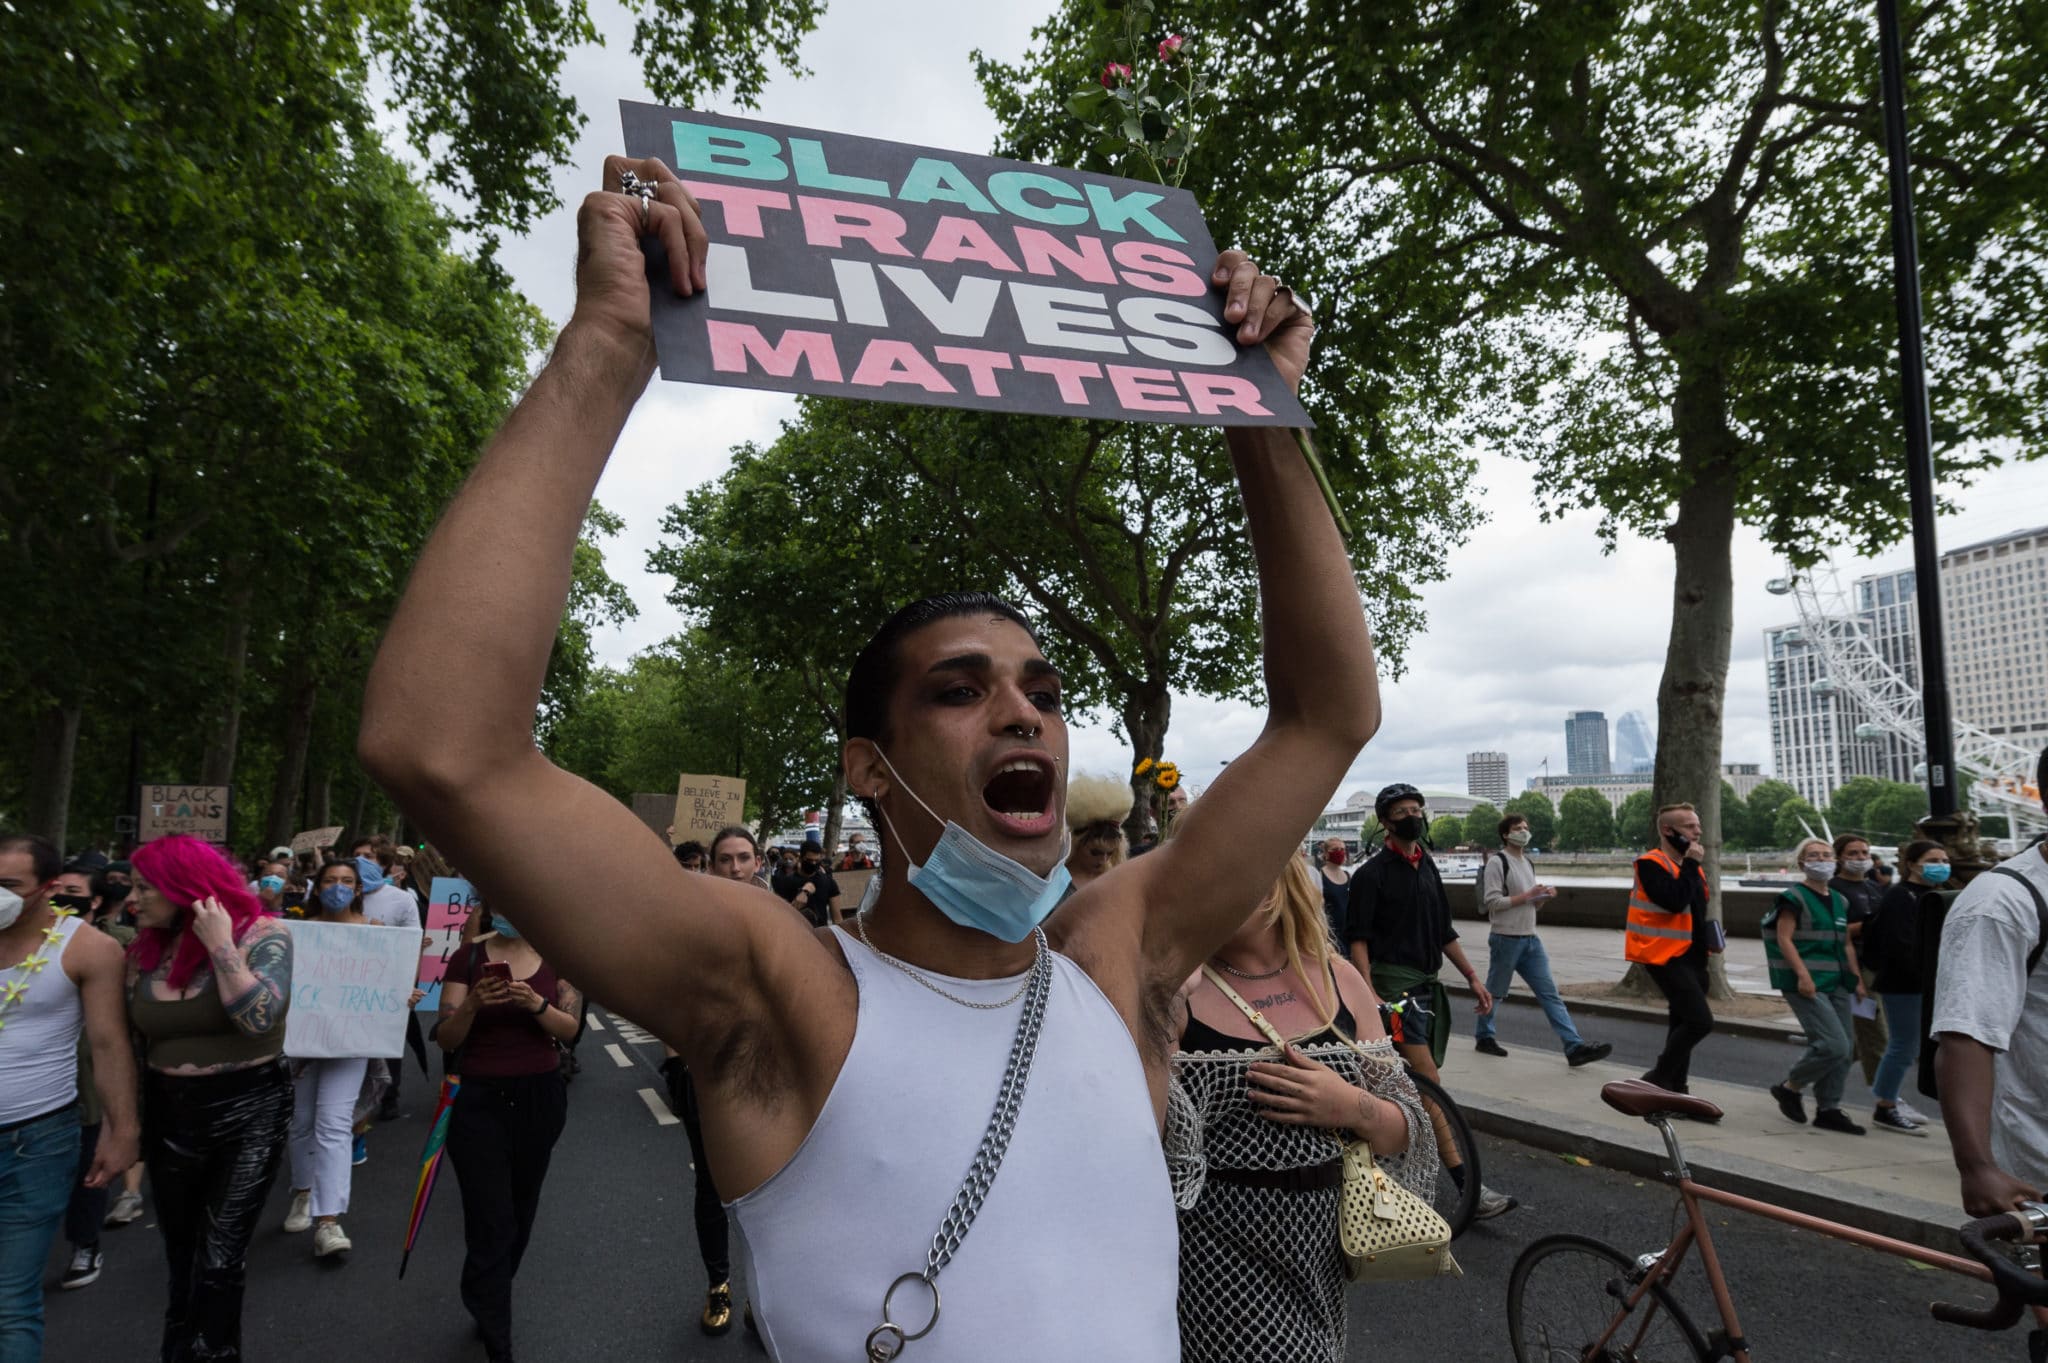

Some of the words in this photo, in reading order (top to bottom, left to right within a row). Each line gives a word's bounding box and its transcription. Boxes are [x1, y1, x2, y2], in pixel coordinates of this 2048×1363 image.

[672, 121, 1189, 243] BLACK
[680, 180, 1207, 297] TRANS
[705, 242, 1237, 366] LIVES
[706, 320, 1276, 416] MATTER
[152, 785, 217, 802] BLACK
[684, 786, 720, 799] BELIEVE
[727, 792, 740, 801] IN
[712, 779, 720, 788] I
[151, 803, 222, 819] TRANS
[695, 798, 728, 811] BLACK
[696, 809, 726, 820] TRANS
[152, 820, 196, 829] LIVES
[311, 952, 389, 983] AMPLIFY
[339, 983, 401, 1013] TRANS
[287, 1013, 374, 1049] VOICES
